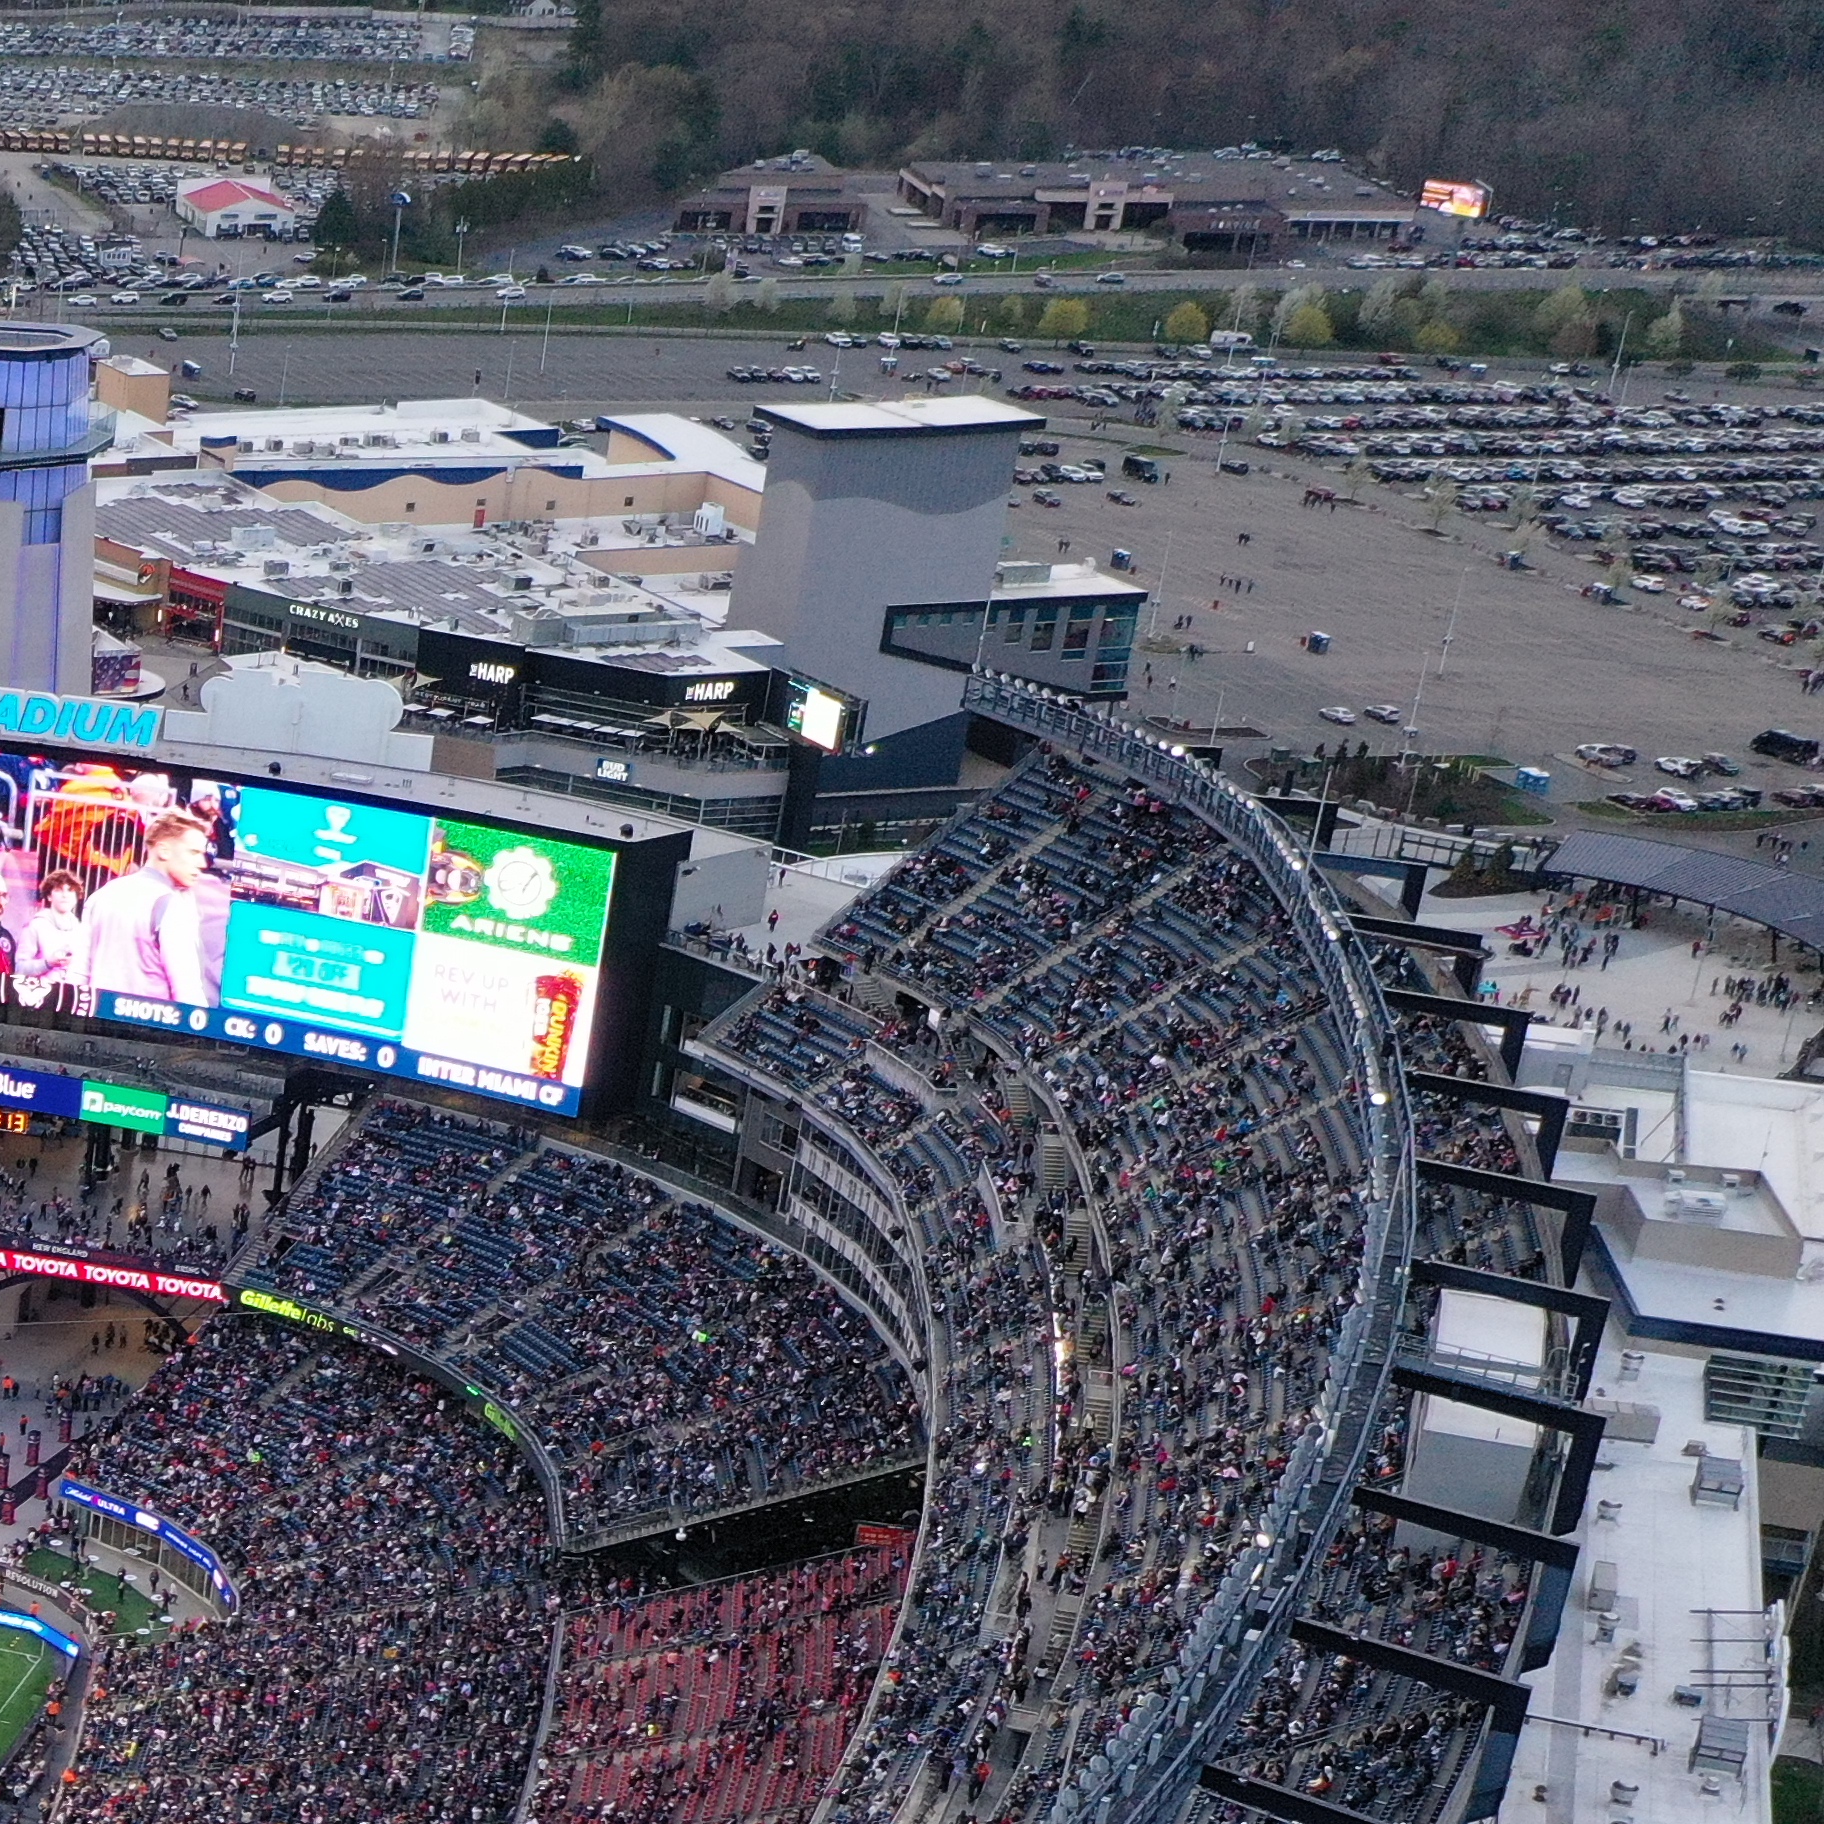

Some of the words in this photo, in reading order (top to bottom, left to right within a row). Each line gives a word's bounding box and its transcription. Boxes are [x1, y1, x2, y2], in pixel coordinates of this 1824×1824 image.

[289, 604, 325, 621] CRAZY
[477, 662, 514, 684] HARP
[694, 682, 734, 701] HARP
[450, 914, 575, 953] ARIENS
[435, 964, 475, 984] REV
[482, 970, 509, 993] UP
[441, 987, 497, 1012] WITH
[114, 997, 179, 1025] SHOTS:
[190, 1010, 208, 1031] 0
[224, 1017, 256, 1040] CK:
[264, 1023, 283, 1044] 0
[304, 1033, 366, 1062] SAVES:
[377, 1046, 395, 1068] 0
[417, 1056, 475, 1086] INTER
[478, 1070, 538, 1103] MIAMI
[540, 1084, 565, 1105] CF
[103, 1099, 162, 1122] paycom
[13, 1254, 78, 1278] TOYOTA
[84, 1266, 150, 1289] TOYOTA
[156, 1276, 222, 1300] TOYOTA
[98, 1500, 125, 1516] ULTRA
[5, 1568, 59, 1598] REVOLUTION
